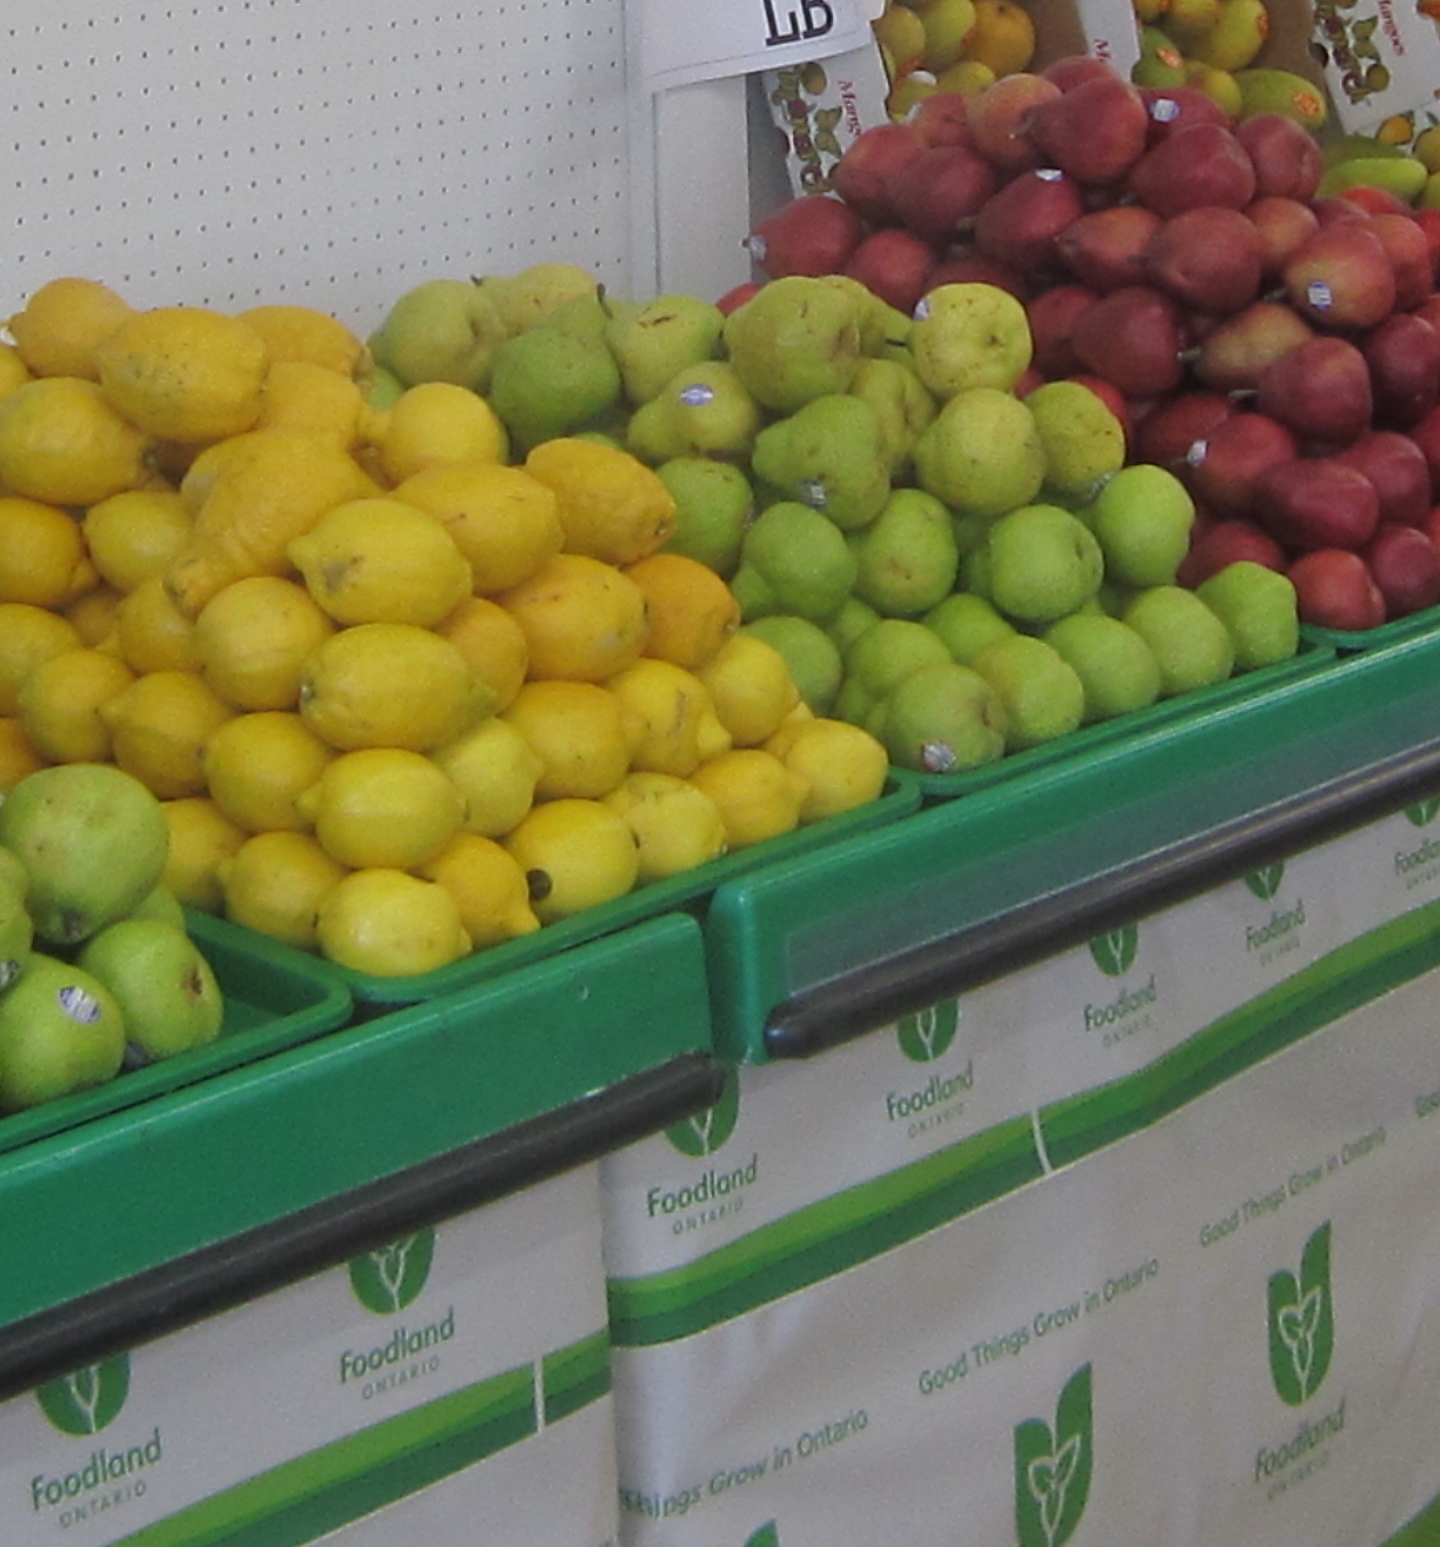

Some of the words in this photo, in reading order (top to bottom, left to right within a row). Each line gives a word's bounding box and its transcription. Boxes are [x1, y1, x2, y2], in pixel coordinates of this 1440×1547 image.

[886, 1060, 974, 1121] Foodland
[647, 1153, 758, 1218] Foodland
[340, 1306, 455, 1385] Foodland
[919, 1353, 969, 1395] Good
[971, 1325, 1031, 1368] Things
[1033, 1302, 1080, 1337] Grow
[1104, 1258, 1158, 1302] Ontario
[362, 1355, 440, 1401] ONTARIO
[32, 1427, 162, 1512] Foodland
[709, 1457, 768, 1496] Grow
[773, 1446, 793, 1473] in
[797, 1408, 869, 1458] Ontario
[59, 1480, 147, 1530] ONTARIO
